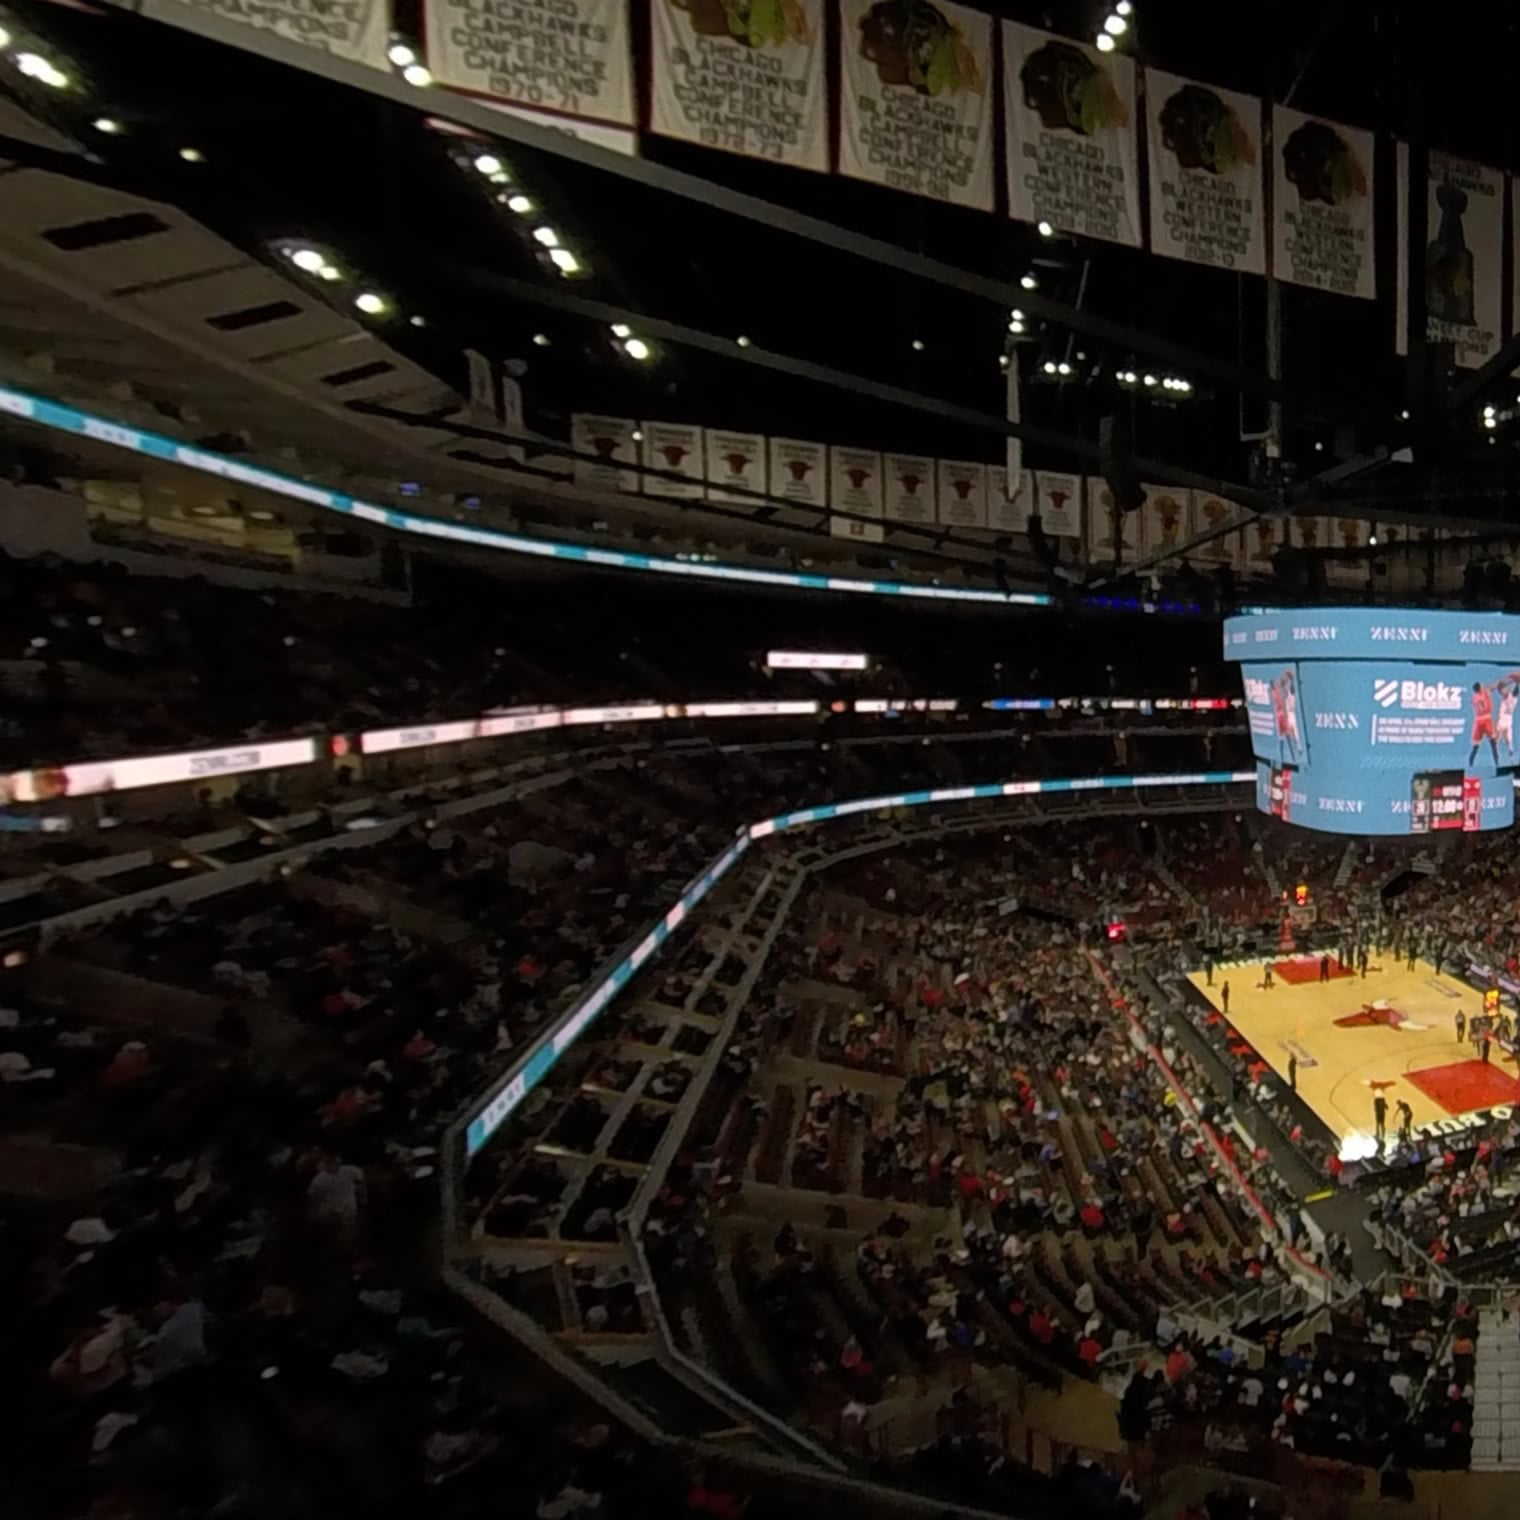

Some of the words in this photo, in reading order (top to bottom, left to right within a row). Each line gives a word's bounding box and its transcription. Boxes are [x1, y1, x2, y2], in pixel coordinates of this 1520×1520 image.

[451, 26, 607, 80] CONFERENCE
[464, 6, 585, 56] CAMPBELL
[696, 36, 782, 73] CHICAGO
[464, 49, 597, 96] CHAMPIONS
[672, 47, 807, 97] BLACKHAWKS
[685, 68, 791, 112] CAMPBELL
[674, 83, 803, 130] CONFERENCE
[683, 104, 797, 146] CHAMPIONS
[1401, 680, 1461, 701] Blokz
